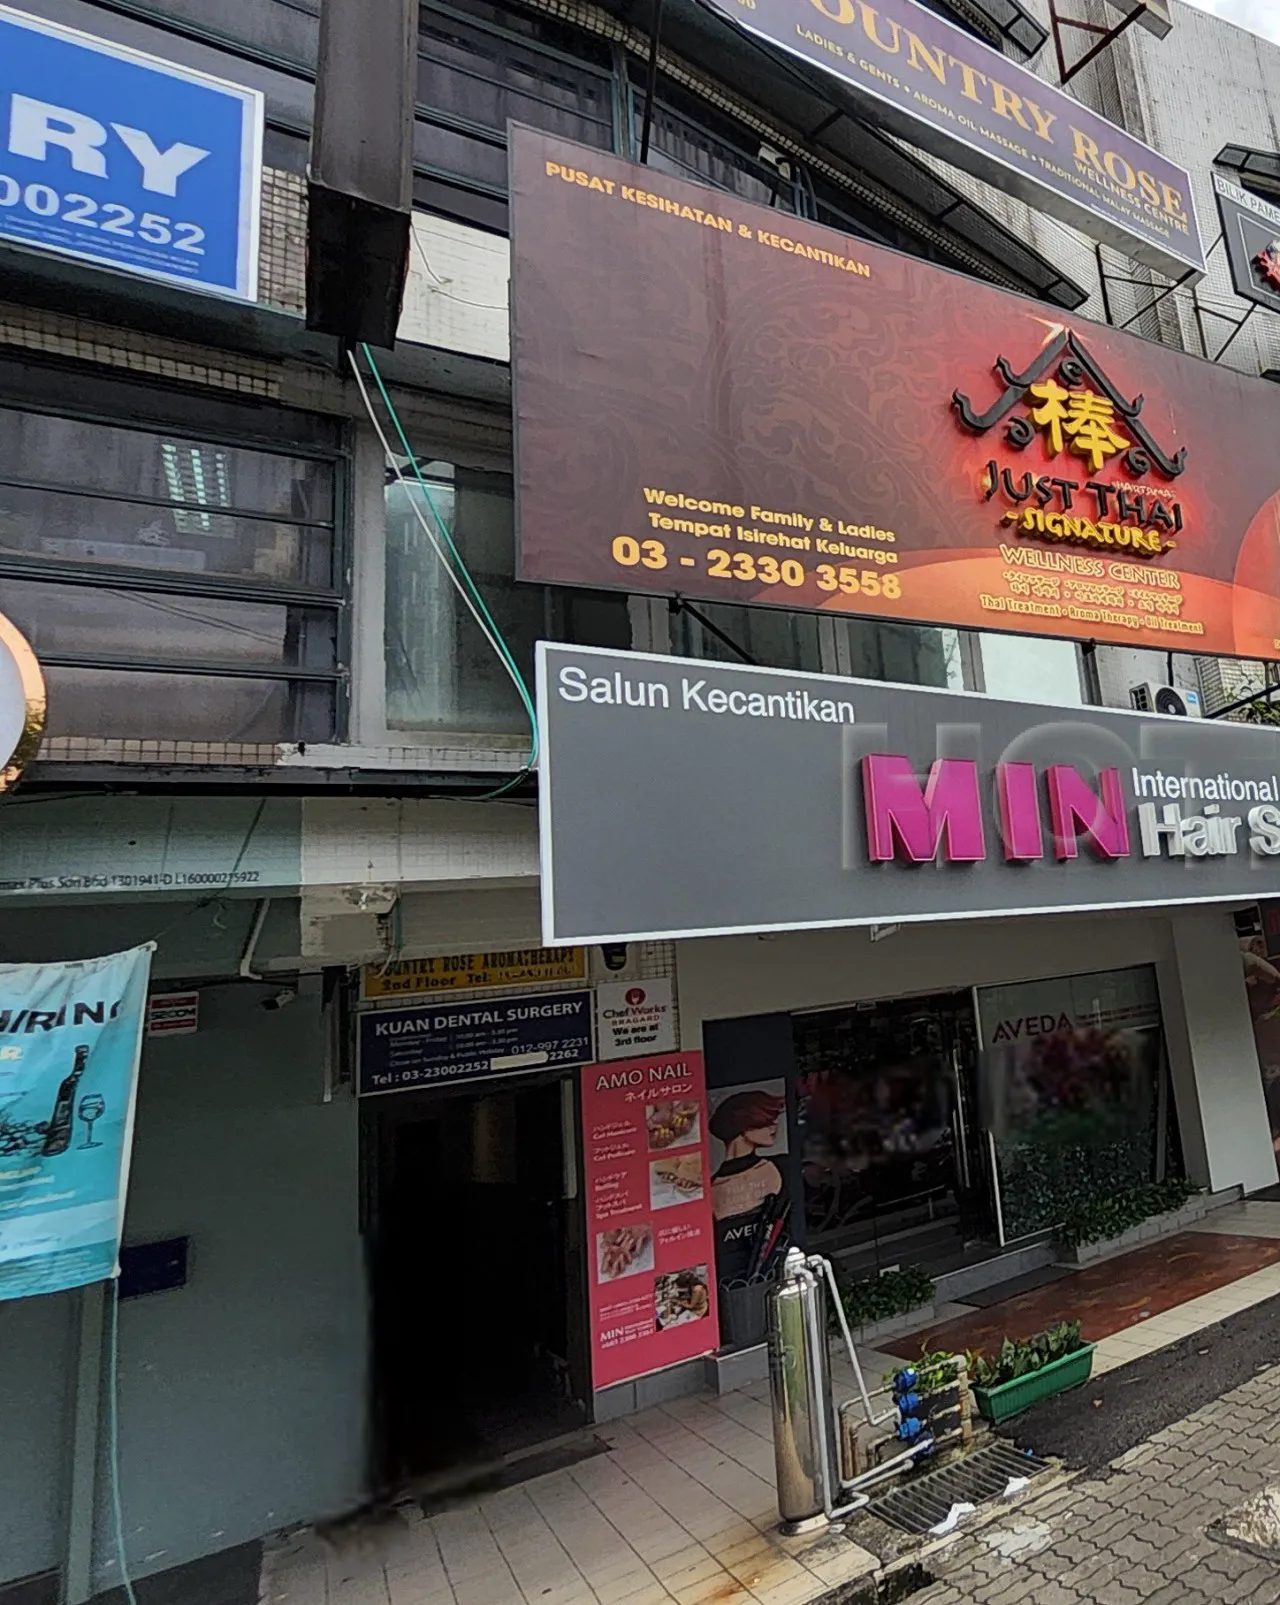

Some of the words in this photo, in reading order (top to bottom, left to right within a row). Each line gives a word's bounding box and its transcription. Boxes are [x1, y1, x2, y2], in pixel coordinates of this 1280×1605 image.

[796, 23, 844, 59] LADIES
[845, 51, 858, 64] &
[859, 58, 900, 89] GENTS
[911, 89, 955, 122] AROMA
[956, 113, 977, 133] OIL
[979, 125, 1028, 158] MASSAGE
[1038, 157, 1101, 198] TRADITIONAL
[8, 93, 212, 198] RY
[1071, 126, 1189, 221] ROSE
[1216, 178, 1247, 205] BILIK
[1073, 159, 1141, 208] WELLNESS
[1143, 201, 1190, 236] CENTRE
[545, 160, 616, 195] PUSAT
[621, 184, 733, 233] KESIHATAN
[738, 222, 753, 240] &
[757, 229, 871, 278] KECANTIKAN
[1030, 377, 1131, 471] 棒
[643, 486, 745, 519] Welcome
[750, 505, 814, 533] Family
[818, 517, 833, 533] &
[837, 519, 896, 543] Ladies
[985, 460, 1079, 510] JUST
[1085, 481, 1185, 534] THAI
[647, 511, 731, 540] Tempat
[816, 538, 899, 566] Keluarga
[1020, 508, 1164, 553] SIGNATURE
[612, 536, 668, 570] 03
[706, 548, 805, 587] 2330
[815, 563, 902, 600] 3558
[998, 543, 1105, 577] WELLNESS
[1108, 563, 1181, 590] CENTER
[979, 593, 1004, 611] Thai
[1006, 597, 1062, 617] Treatment
[1069, 605, 1100, 621] Aroma
[1102, 608, 1139, 630] Therapy
[558, 666, 669, 708] Salun
[682, 678, 855, 724] Kecantikan
[1131, 767, 1280, 802] International
[861, 752, 1131, 865] MIN
[1138, 802, 1242, 857] Hair
[443, 953, 475, 973] ROSE
[381, 976, 411, 991] 2nd
[416, 975, 457, 989] Floor
[375, 1017, 431, 1036] KUAN
[433, 1008, 504, 1031] DENTAL
[506, 1001, 583, 1022] SURGERY
[602, 1007, 629, 1019] Chef
[630, 1004, 667, 1016] Works
[611, 1014, 660, 1026] BRAGARD
[612, 1027, 629, 1036] We
[631, 1025, 647, 1034] are
[648, 1023, 659, 1031] at
[991, 1011, 1074, 1044] AVEDA
[559, 1036, 589, 1050] 2231
[614, 1036, 632, 1047] 3rd
[633, 1034, 657, 1044] floor
[372, 1072, 393, 1086] Tel
[402, 1059, 489, 1081] 03-23002252
[548, 1048, 579, 1061] 2262
[596, 1069, 644, 1092] AMO
[648, 1062, 693, 1083] NAIL
[624, 1082, 693, 1103] ネイルサロン
[600, 1325, 624, 1342] MIN
